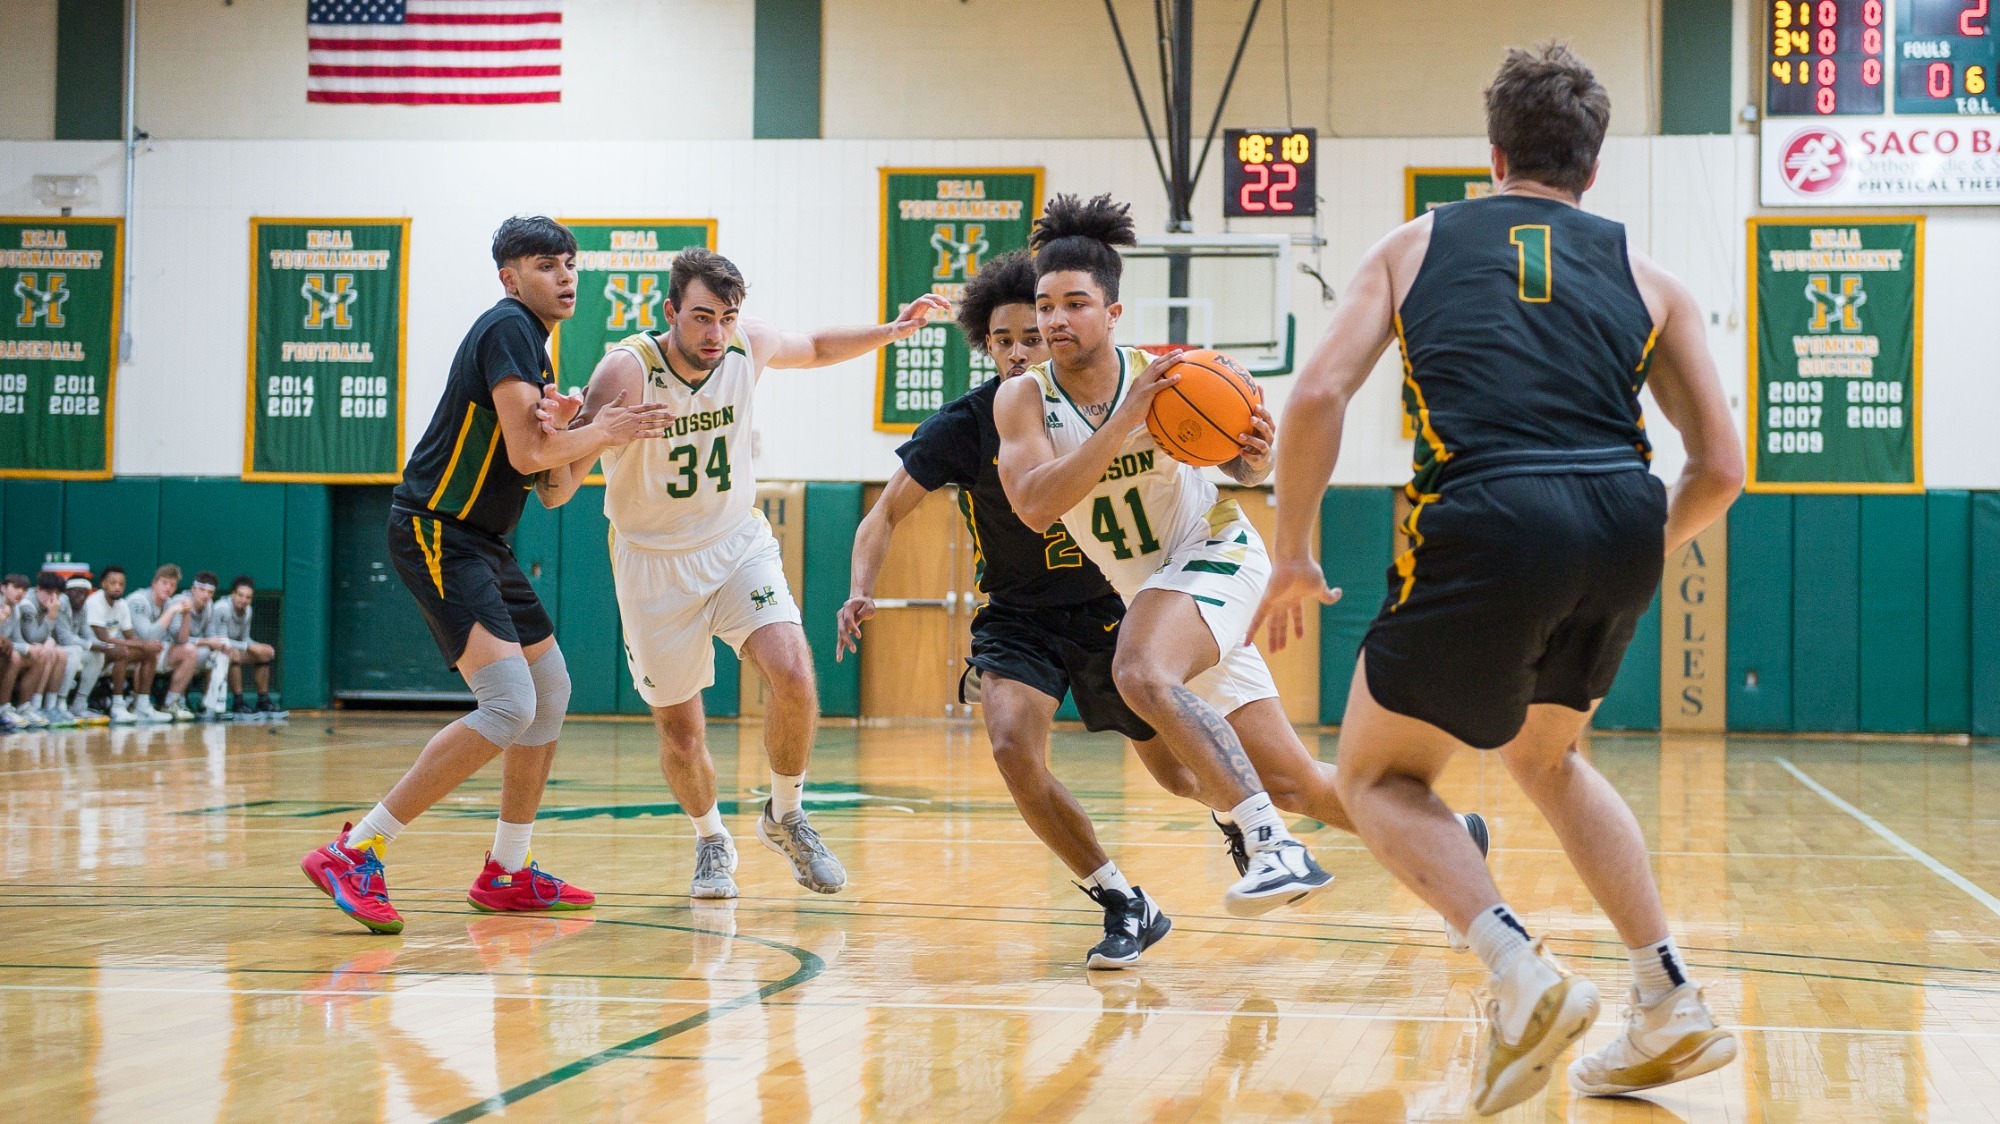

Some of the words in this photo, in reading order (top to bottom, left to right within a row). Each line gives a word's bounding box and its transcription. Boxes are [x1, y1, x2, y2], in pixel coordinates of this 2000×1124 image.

[1774, 0, 1810, 28] 31
[1773, 28, 1810, 57] 34
[1817, 28, 1836, 56] 0
[1863, 27, 1882, 55] 0
[1903, 40, 1951, 59] FOULS
[1771, 60, 1810, 85] 41
[1817, 58, 1836, 86] 0
[1862, 58, 1882, 85] 0
[1928, 61, 1952, 99] 0
[1964, 65, 1985, 94] 6
[1816, 87, 1836, 114] 0
[1238, 133, 1309, 164] 18:10
[1860, 130, 1959, 155] SACO
[1972, 130, 2000, 154] B
[937, 180, 986, 200] NCAA
[1240, 162, 1297, 213] 22
[1858, 178, 1950, 193] PHYSICAL
[899, 200, 1023, 221] TOURNAMENT
[21, 230, 67, 249] NCAA
[307, 230, 353, 250] NCAA
[610, 230, 658, 250] NCAA
[1810, 229, 1862, 250] NCAA
[270, 250, 390, 270] TOURNAMENT
[576, 251, 675, 271] TOURNAME
[1508, 223, 1552, 304] 1
[1769, 250, 1903, 271] TOURNAMENT
[281, 341, 374, 362] FOOTBALL
[1793, 335, 1880, 357] WOMENS
[896, 348, 944, 369] 2013
[1797, 357, 1873, 378] SOCCER
[54, 375, 95, 394] 2011
[268, 375, 314, 396] 2014
[1213, 355, 1257, 396] NCAA
[895, 390, 944, 410] 2019
[1768, 381, 1824, 403] 2003
[49, 396, 100, 415] 2022
[267, 397, 314, 417] 2017
[1768, 406, 1823, 428] 2007
[1768, 431, 1824, 454] 2009
[667, 436, 732, 499] 34
[1091, 486, 1161, 560] 41
